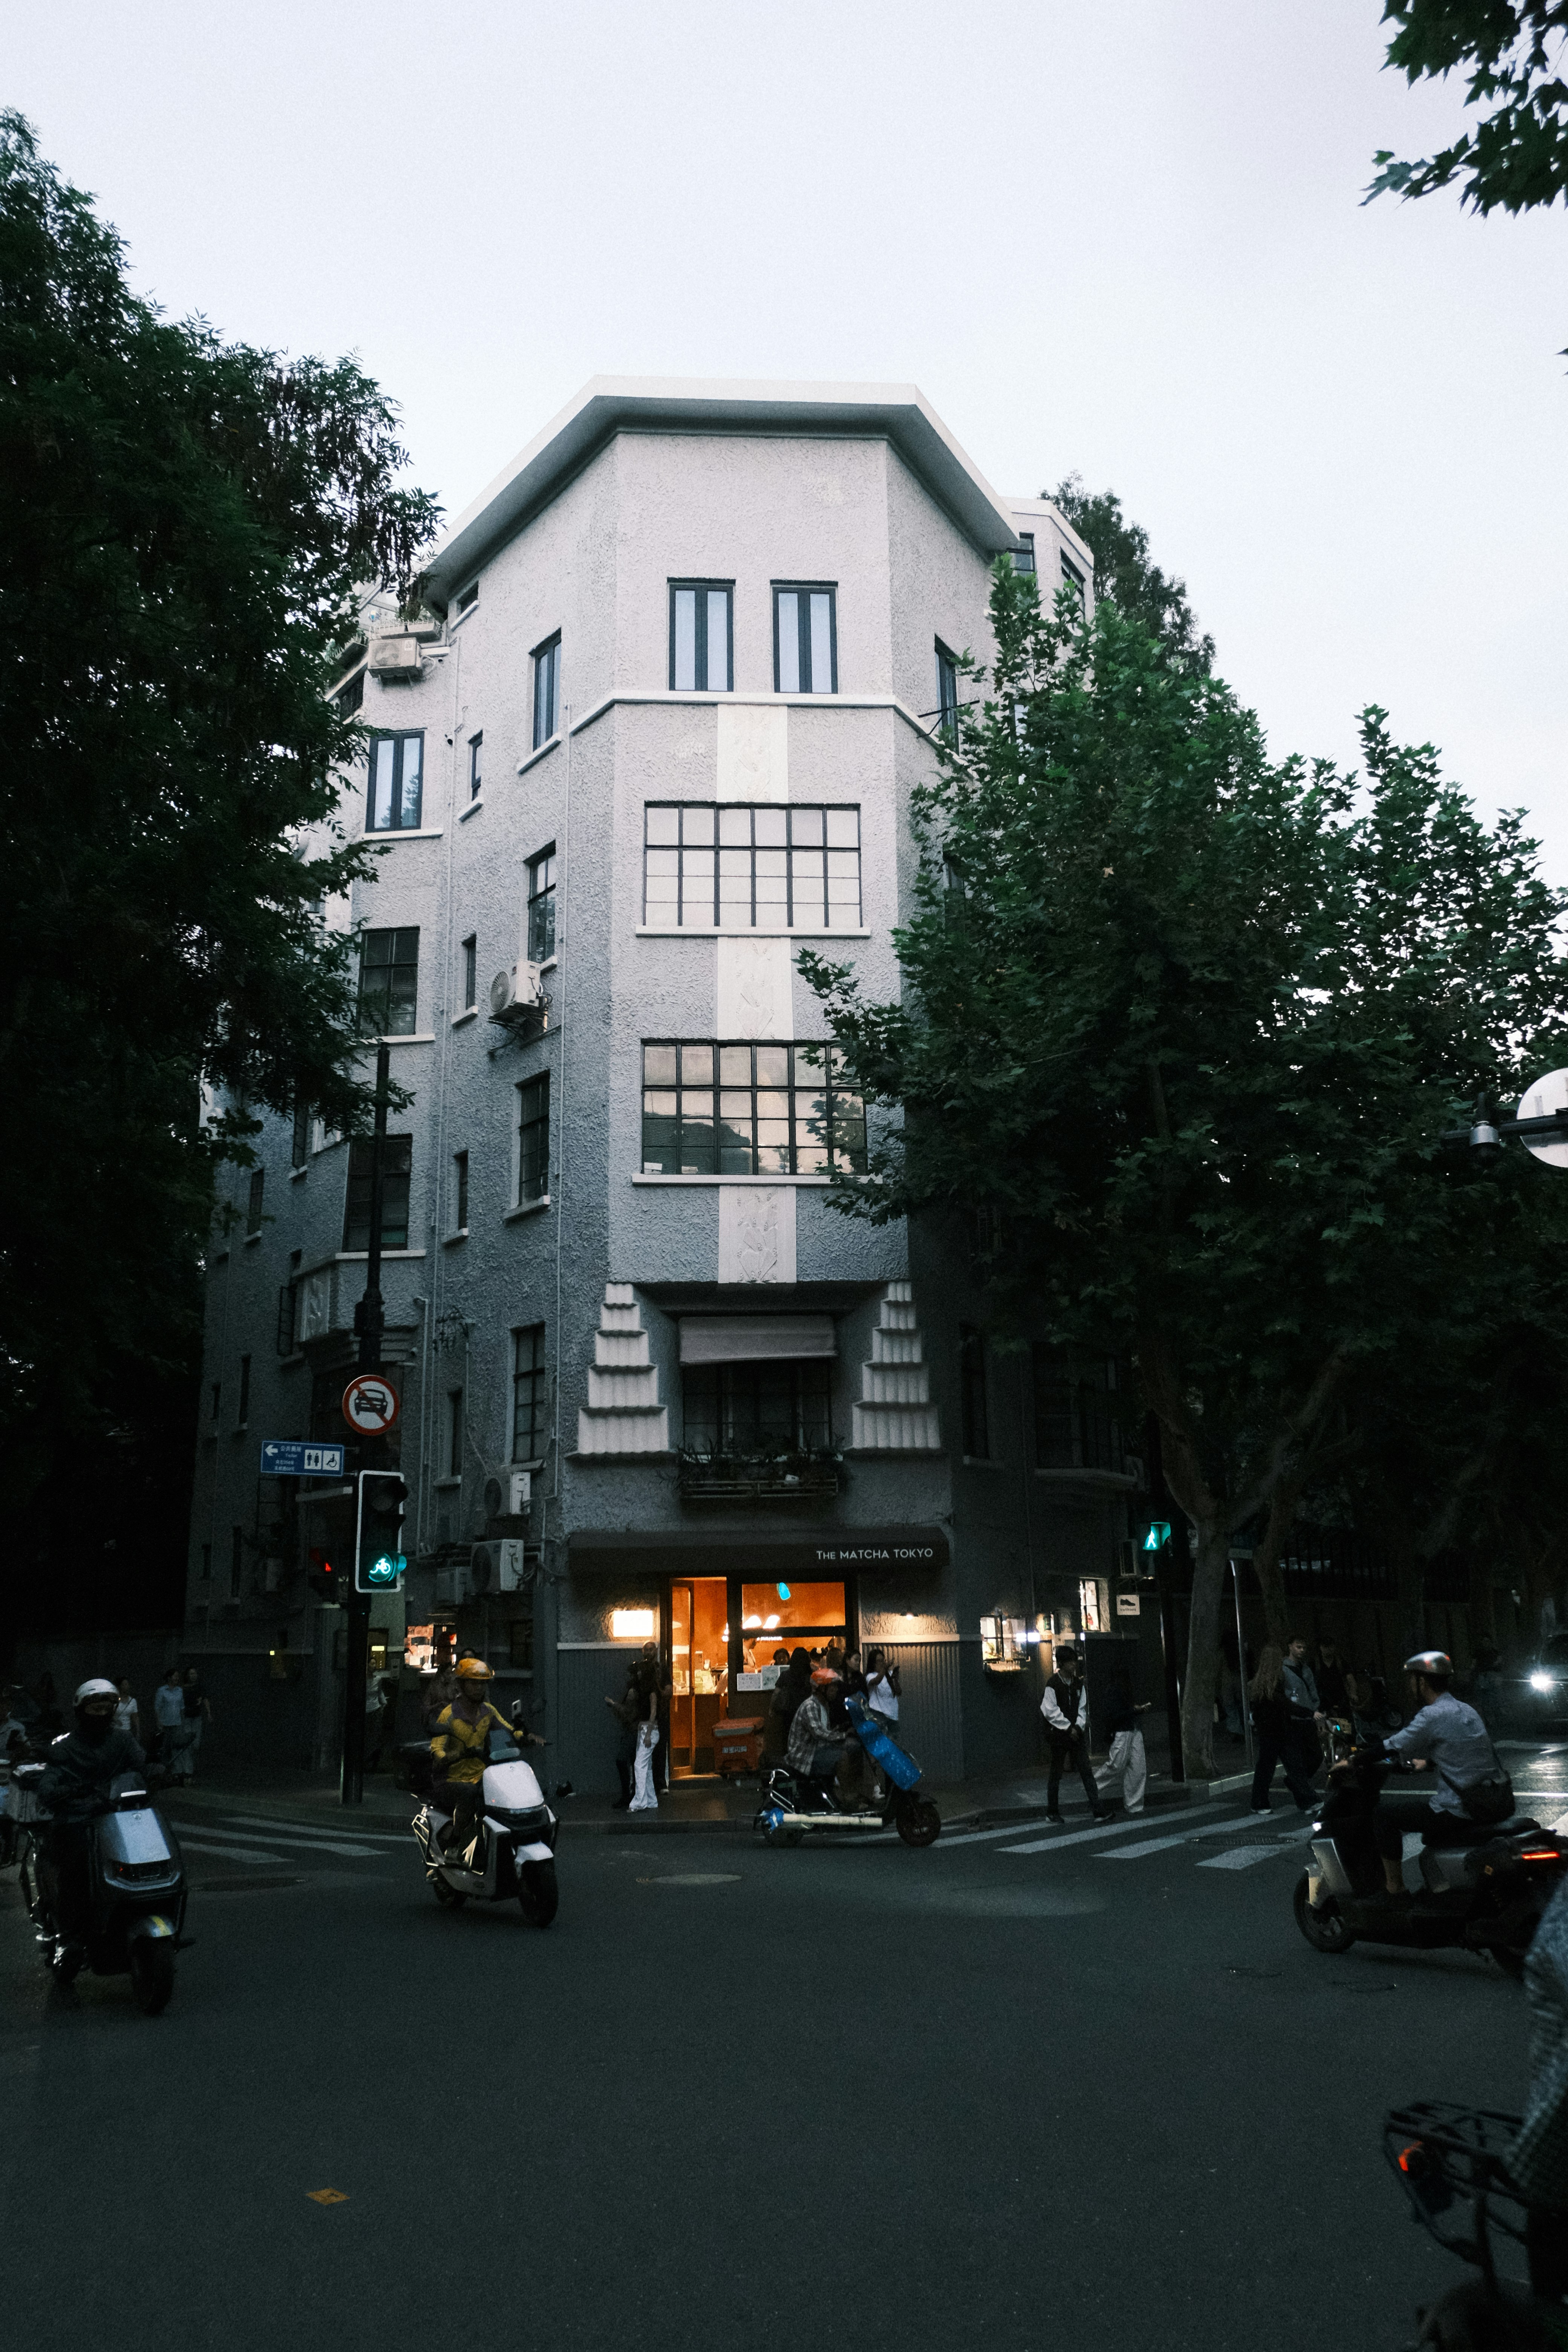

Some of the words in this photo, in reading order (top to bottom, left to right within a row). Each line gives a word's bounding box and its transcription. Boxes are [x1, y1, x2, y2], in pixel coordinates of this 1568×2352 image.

[816, 1550, 836, 1559] THE
[840, 1549, 890, 1559] MATCHA
[893, 1548, 933, 1558] TOKYO
